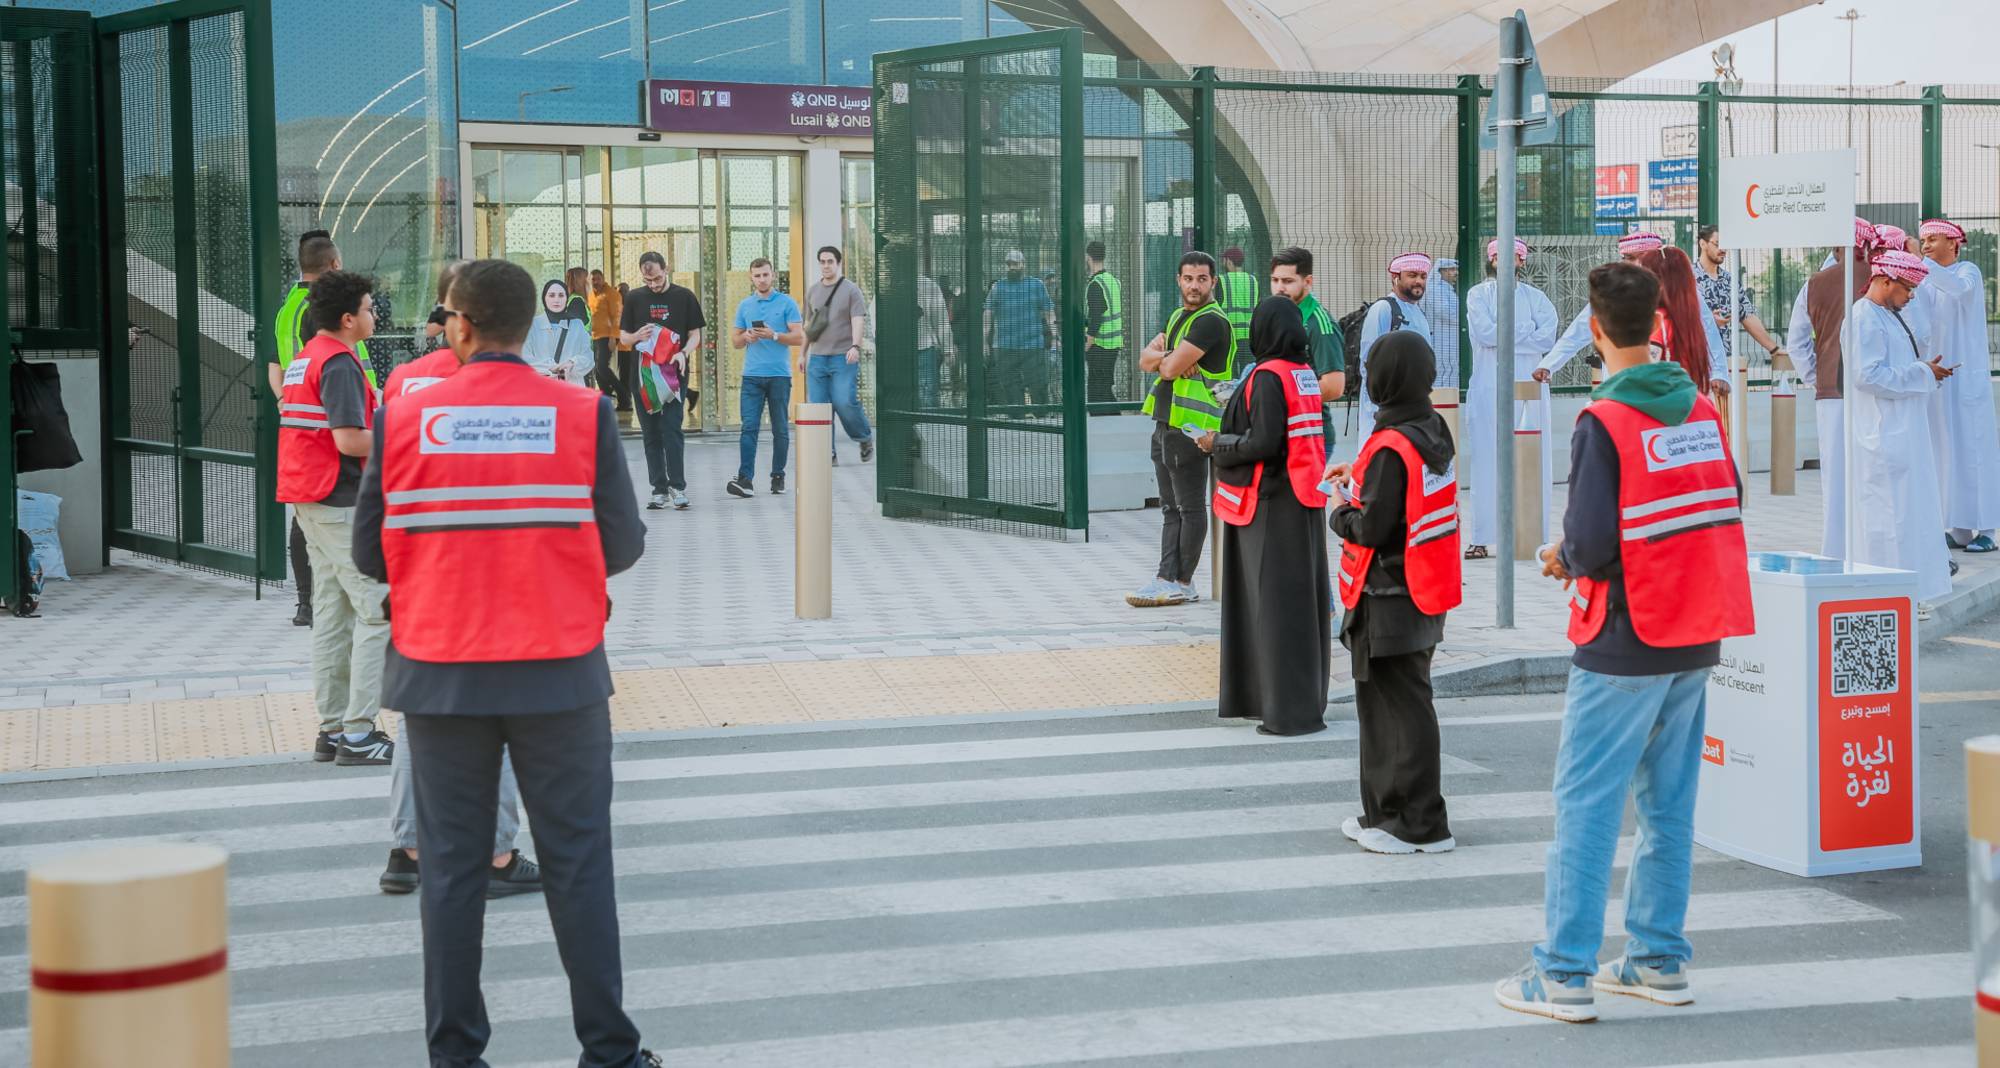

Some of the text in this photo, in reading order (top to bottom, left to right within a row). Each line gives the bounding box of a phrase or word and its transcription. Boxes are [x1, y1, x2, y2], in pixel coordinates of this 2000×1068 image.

[807, 93, 871, 111] QNB لوسيل
[790, 113, 872, 128] Lusail QNB
[1763, 200, 1826, 215] Qatar Red Crescent
[452, 430, 550, 441] Qatar Red Crescent
[1739, 658, 1766, 674] الهلال
[1711, 671, 1768, 695] Red Crescent
[1841, 705, 1864, 720] وتبرع
[1841, 735, 1894, 771] الحياة
[1846, 769, 1890, 808] لغزة
